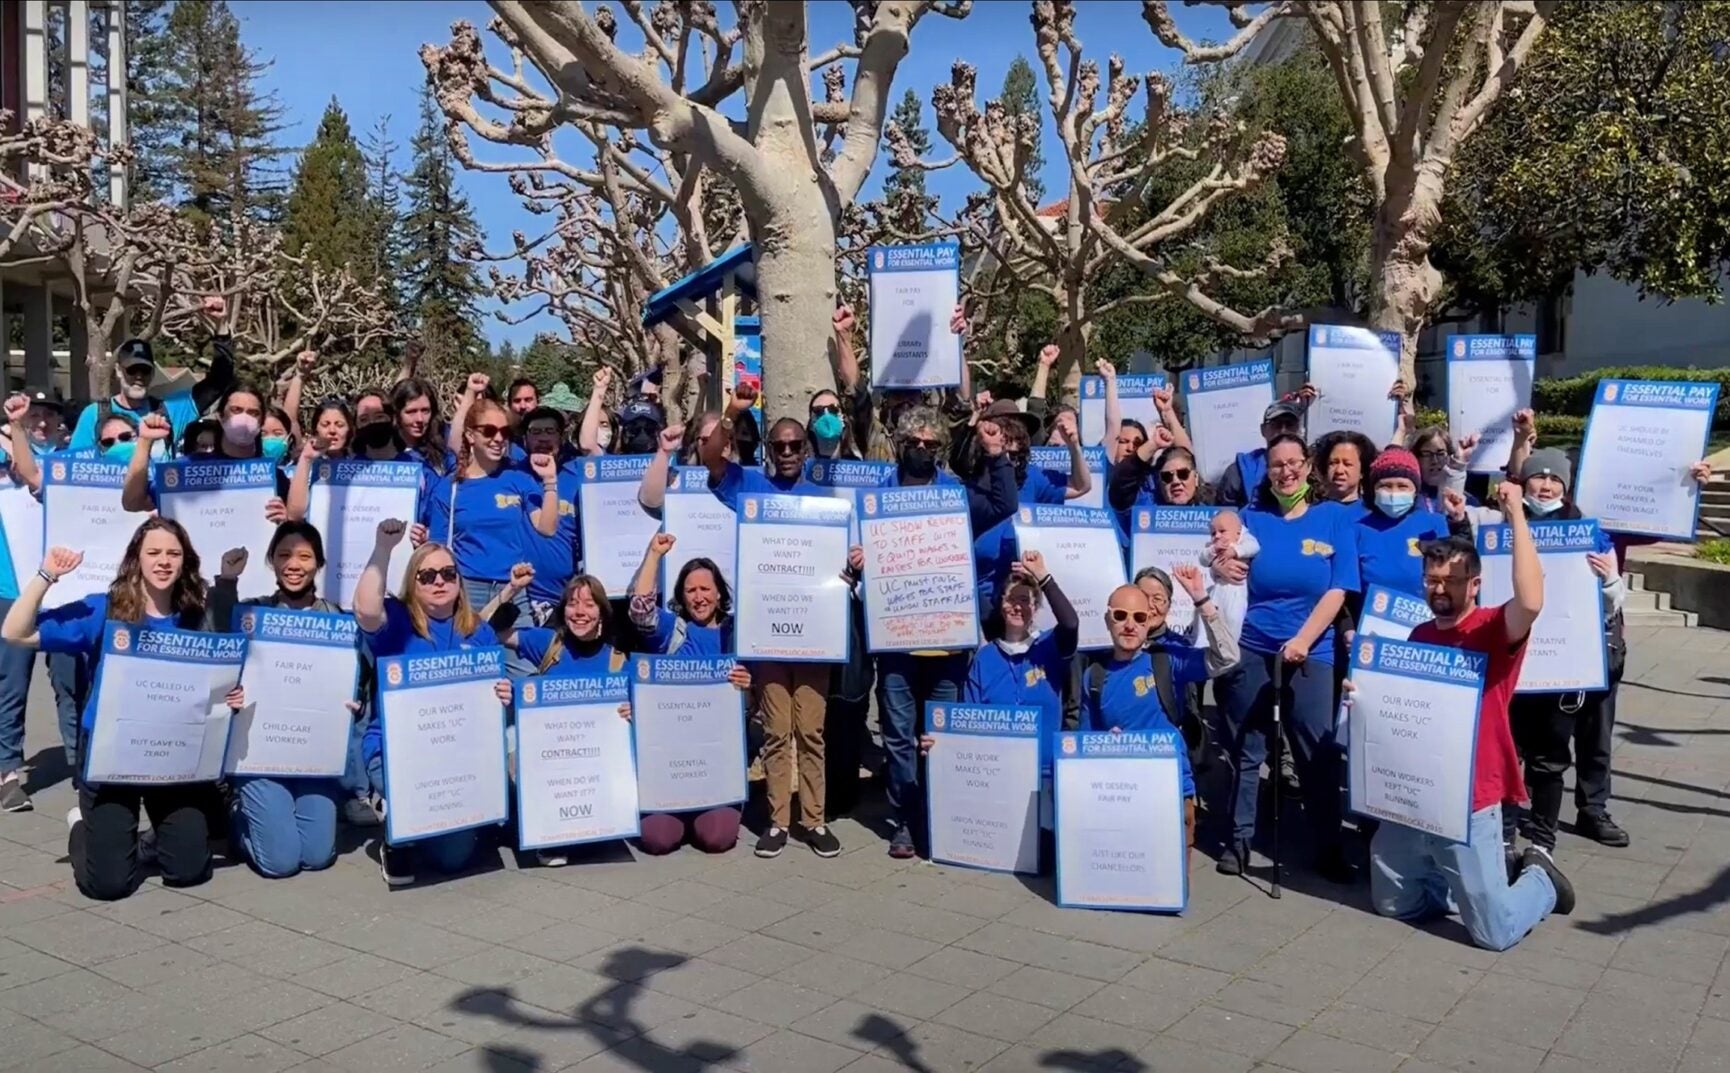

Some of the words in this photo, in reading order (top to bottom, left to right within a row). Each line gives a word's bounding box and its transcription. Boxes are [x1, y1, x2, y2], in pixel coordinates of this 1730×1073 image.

[888, 248, 936, 259] ESSENTIAL
[937, 247, 956, 257] PAY
[1470, 339, 1520, 348] ESSENTIAL
[1203, 367, 1249, 380] ESSENTIAL
[1252, 364, 1269, 373] PAY
[1217, 376, 1249, 385] ESSENTIAL
[1250, 372, 1270, 380] WORK
[1624, 384, 1687, 396] ESSENTIAL
[1689, 388, 1714, 397] PAY
[1639, 395, 1684, 403] ESSENTIAL
[1083, 451, 1103, 460] PAY
[185, 464, 249, 476] ESSENTIAL
[250, 463, 272, 474] PAY
[337, 463, 395, 474] ESSENTIAL
[396, 465, 419, 475] PAY
[829, 464, 881, 475] ESSENTIAL
[185, 477, 202, 485] FOR
[204, 476, 246, 484] ESSENTIAL
[882, 490, 940, 503] ESSENTIAL
[942, 489, 964, 499] PAY
[883, 503, 898, 512] FOR
[900, 501, 940, 510] ESSENTIAL
[941, 500, 965, 508] WORK
[763, 510, 779, 518] FOR
[1036, 507, 1089, 517] ESSENTIAL
[1155, 510, 1211, 521] ESSENTIAL
[870, 523, 888, 536] UC
[893, 522, 922, 532] SHOW
[1568, 524, 1594, 536] PAY
[874, 538, 887, 549] TO
[893, 536, 925, 547] STAFF
[934, 530, 956, 541] WITH
[1566, 537, 1594, 545] WORK
[758, 563, 815, 574] CONTRACT!!!!
[879, 581, 901, 595] UC
[1392, 608, 1409, 618] FOR
[263, 613, 332, 630] ESSENTIAL
[335, 620, 358, 632] PAY
[262, 626, 281, 634] FOR
[282, 628, 330, 639] ESSENTIAL
[331, 632, 359, 642] WORK
[772, 623, 803, 634] NOW
[138, 630, 214, 649] ESSENTIAL
[217, 639, 245, 650] PAY
[137, 643, 158, 652] FOR
[159, 646, 210, 658] ESSENTIAL
[213, 650, 242, 658] WORK
[1381, 643, 1451, 666] ESSENTIAL
[1454, 654, 1482, 669] PAY
[275, 661, 294, 669] FAIR
[408, 653, 475, 672] ESSENTIAL
[477, 651, 501, 663] PAY
[655, 659, 714, 671] ESSENTIAL
[409, 671, 427, 681] FOR
[428, 667, 473, 680] ESSENTIAL
[474, 664, 501, 673] WORK
[1379, 657, 1398, 668] FOR
[1400, 661, 1448, 676] ESSENTIAL
[1449, 667, 1480, 680] WORK
[284, 676, 301, 684] FOR
[655, 671, 670, 679] FOR
[672, 671, 712, 679] ESSENTIAL
[150, 681, 181, 690] CALLED
[542, 678, 604, 692] ESSENTIAL
[605, 676, 628, 687] PAY
[148, 694, 180, 702] HEROES
[542, 691, 559, 699] FOR
[560, 689, 600, 699] ESSENTIAL
[603, 688, 628, 697] WORK
[1382, 695, 1401, 706] OUR
[1404, 699, 1431, 710] WORK
[418, 708, 437, 716] OUR
[439, 704, 464, 714] WORK
[951, 708, 1012, 721] ESSENTIAL
[1015, 710, 1039, 722] PAY
[1380, 710, 1408, 721] MAKES
[1411, 715, 1432, 725] "UC"
[263, 722, 311, 733] CHILD-CARE
[417, 721, 446, 731] MAKES
[544, 722, 568, 730] WHAT
[951, 720, 967, 728] FOR
[968, 722, 1010, 730] ESSENTIAL
[1011, 723, 1038, 731] WORK
[1082, 734, 1148, 744] ESSENTIAL
[1151, 734, 1176, 743] PAY
[1392, 728, 1418, 739] WORK
[266, 736, 307, 744] WORKERS
[430, 736, 456, 745] WORK
[1149, 744, 1176, 752] WORK
[956, 752, 974, 760] OUR
[976, 753, 998, 761] WORK
[955, 765, 981, 774] MAKES
[1372, 765, 1396, 778] UNION
[1398, 773, 1434, 786] WORKERS
[547, 778, 572, 787] WHEN
[966, 780, 989, 788] WORK
[1385, 782, 1402, 790] KEPT
[554, 791, 578, 800] WANT
[1385, 794, 1419, 808] RUNNING
[559, 804, 592, 818] NOW
